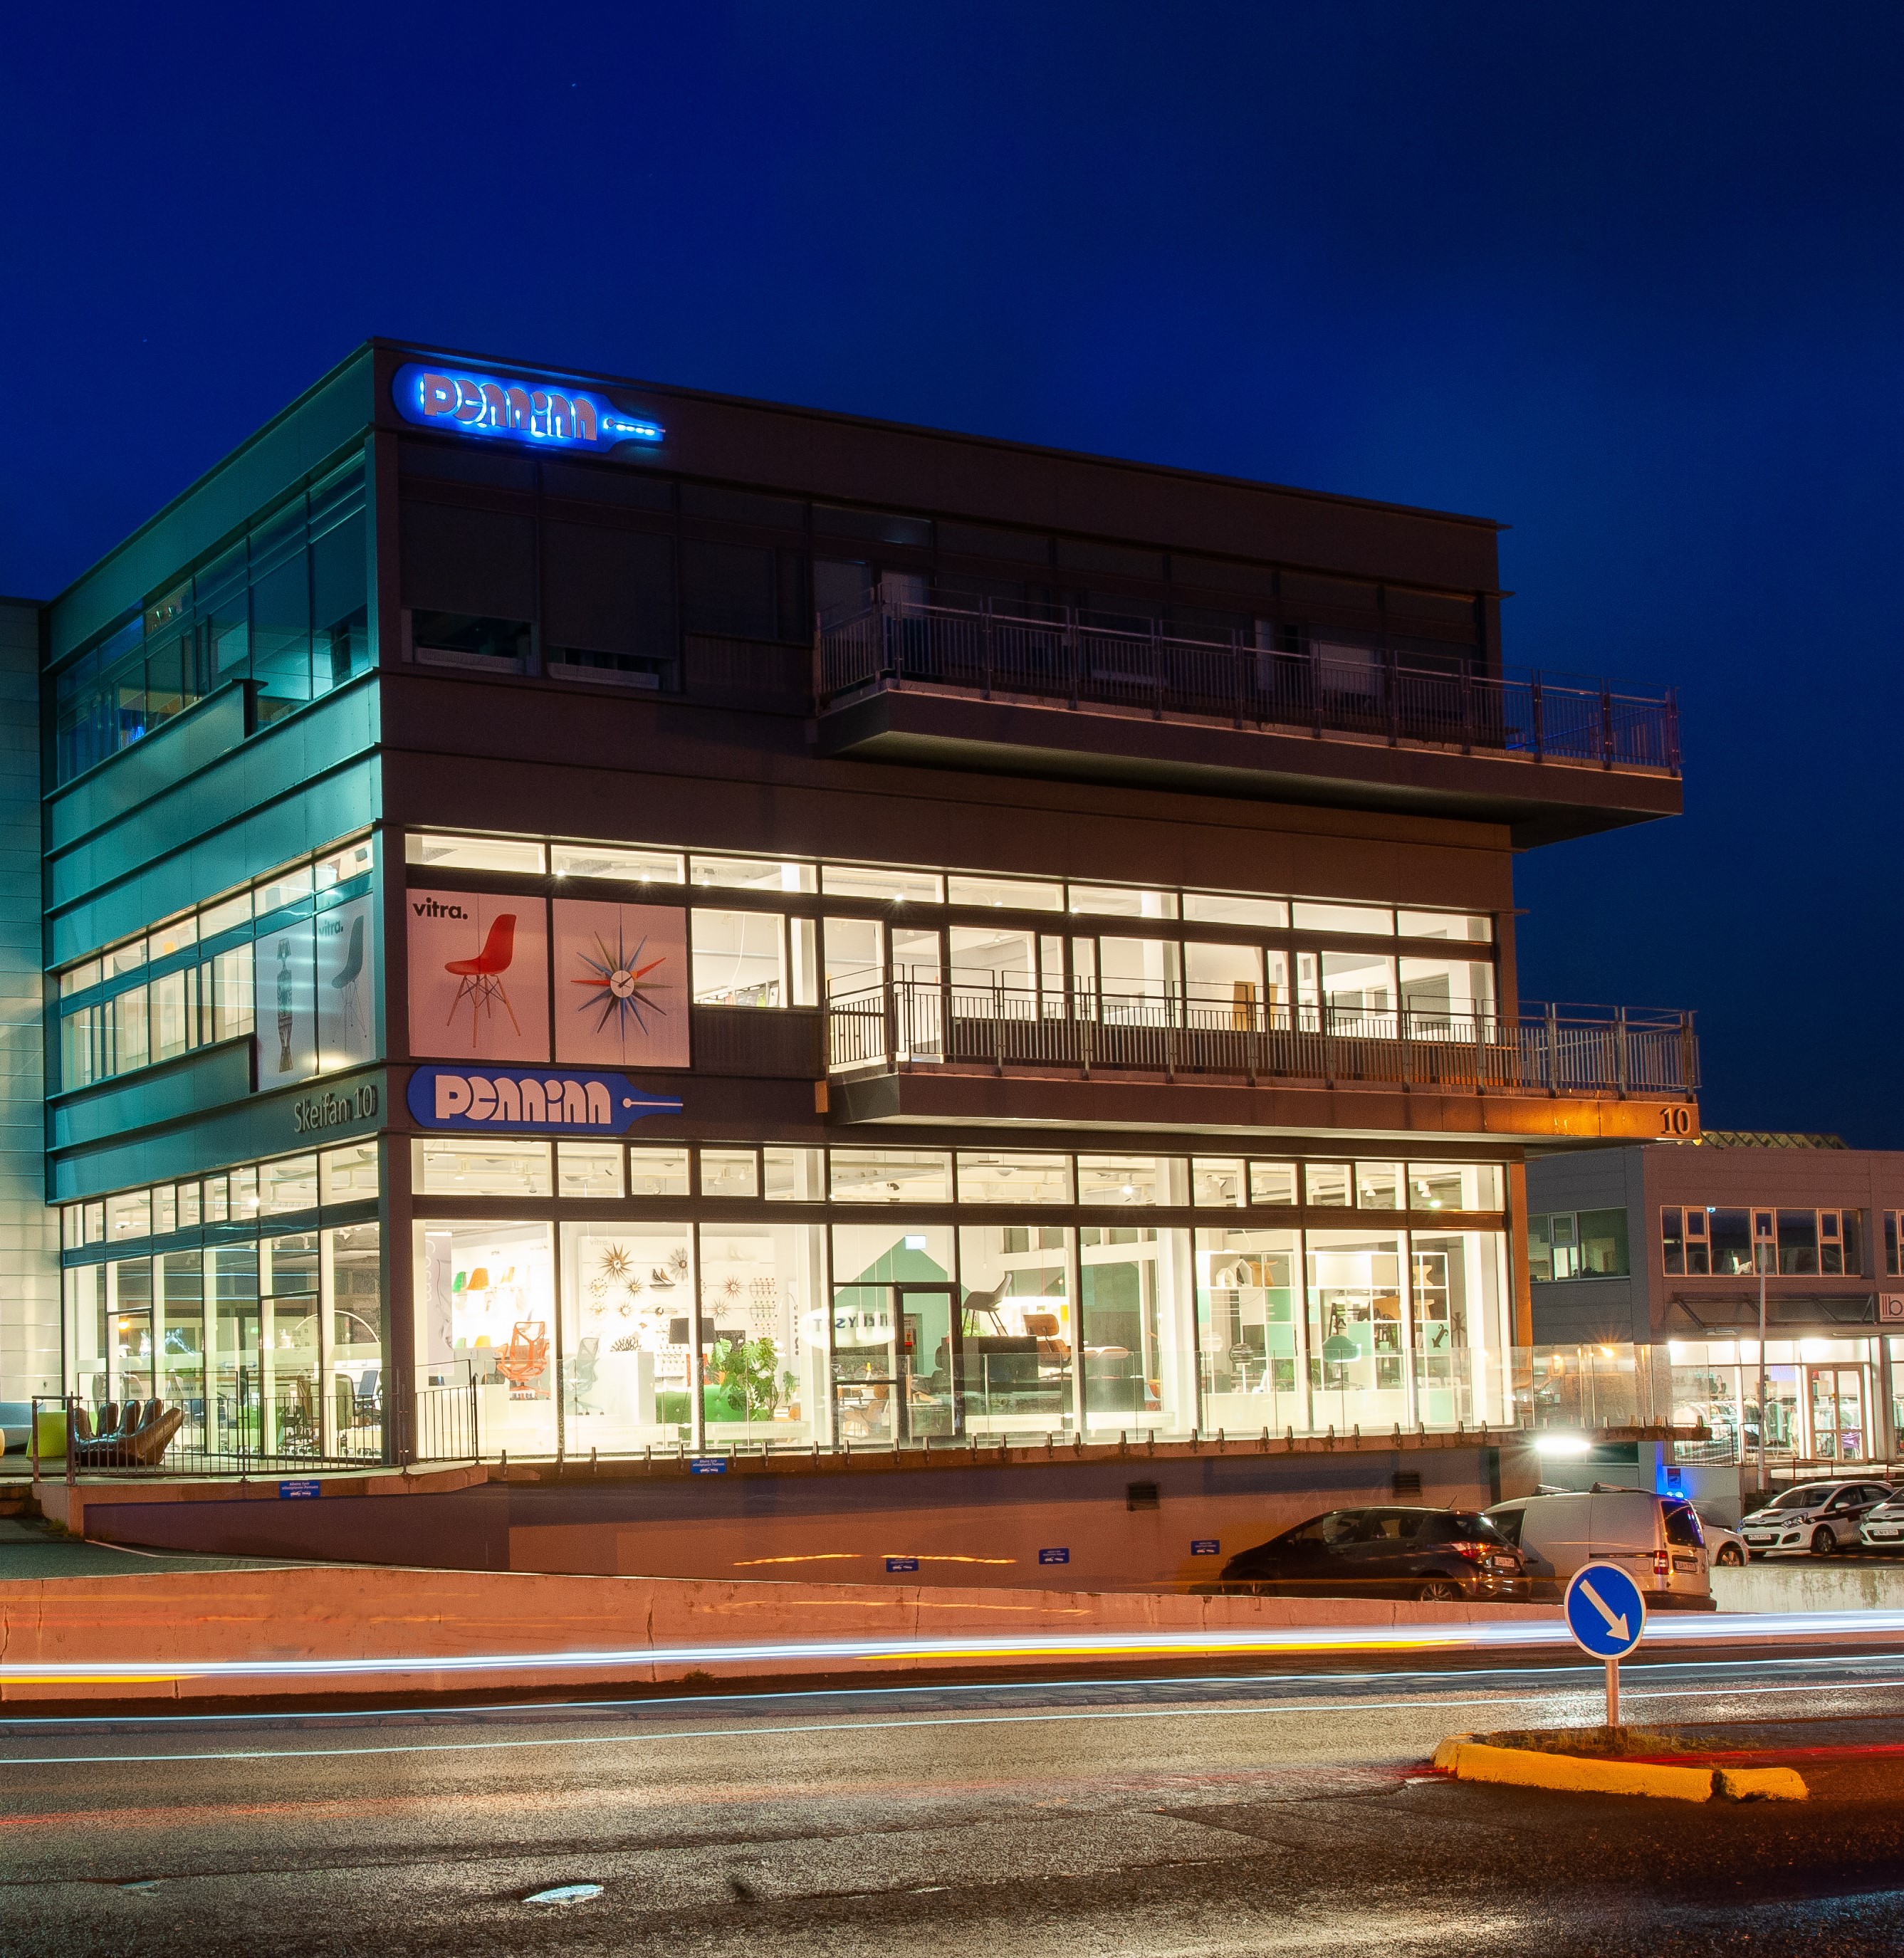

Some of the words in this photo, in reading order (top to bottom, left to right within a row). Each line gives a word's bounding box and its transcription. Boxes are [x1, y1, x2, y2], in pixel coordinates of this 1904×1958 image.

[412, 896, 468, 920] vitra.
[318, 920, 343, 936] vitra.
[294, 1092, 348, 1134] Skeifan
[354, 1084, 375, 1119] 10
[1660, 1107, 1690, 1135] 10
